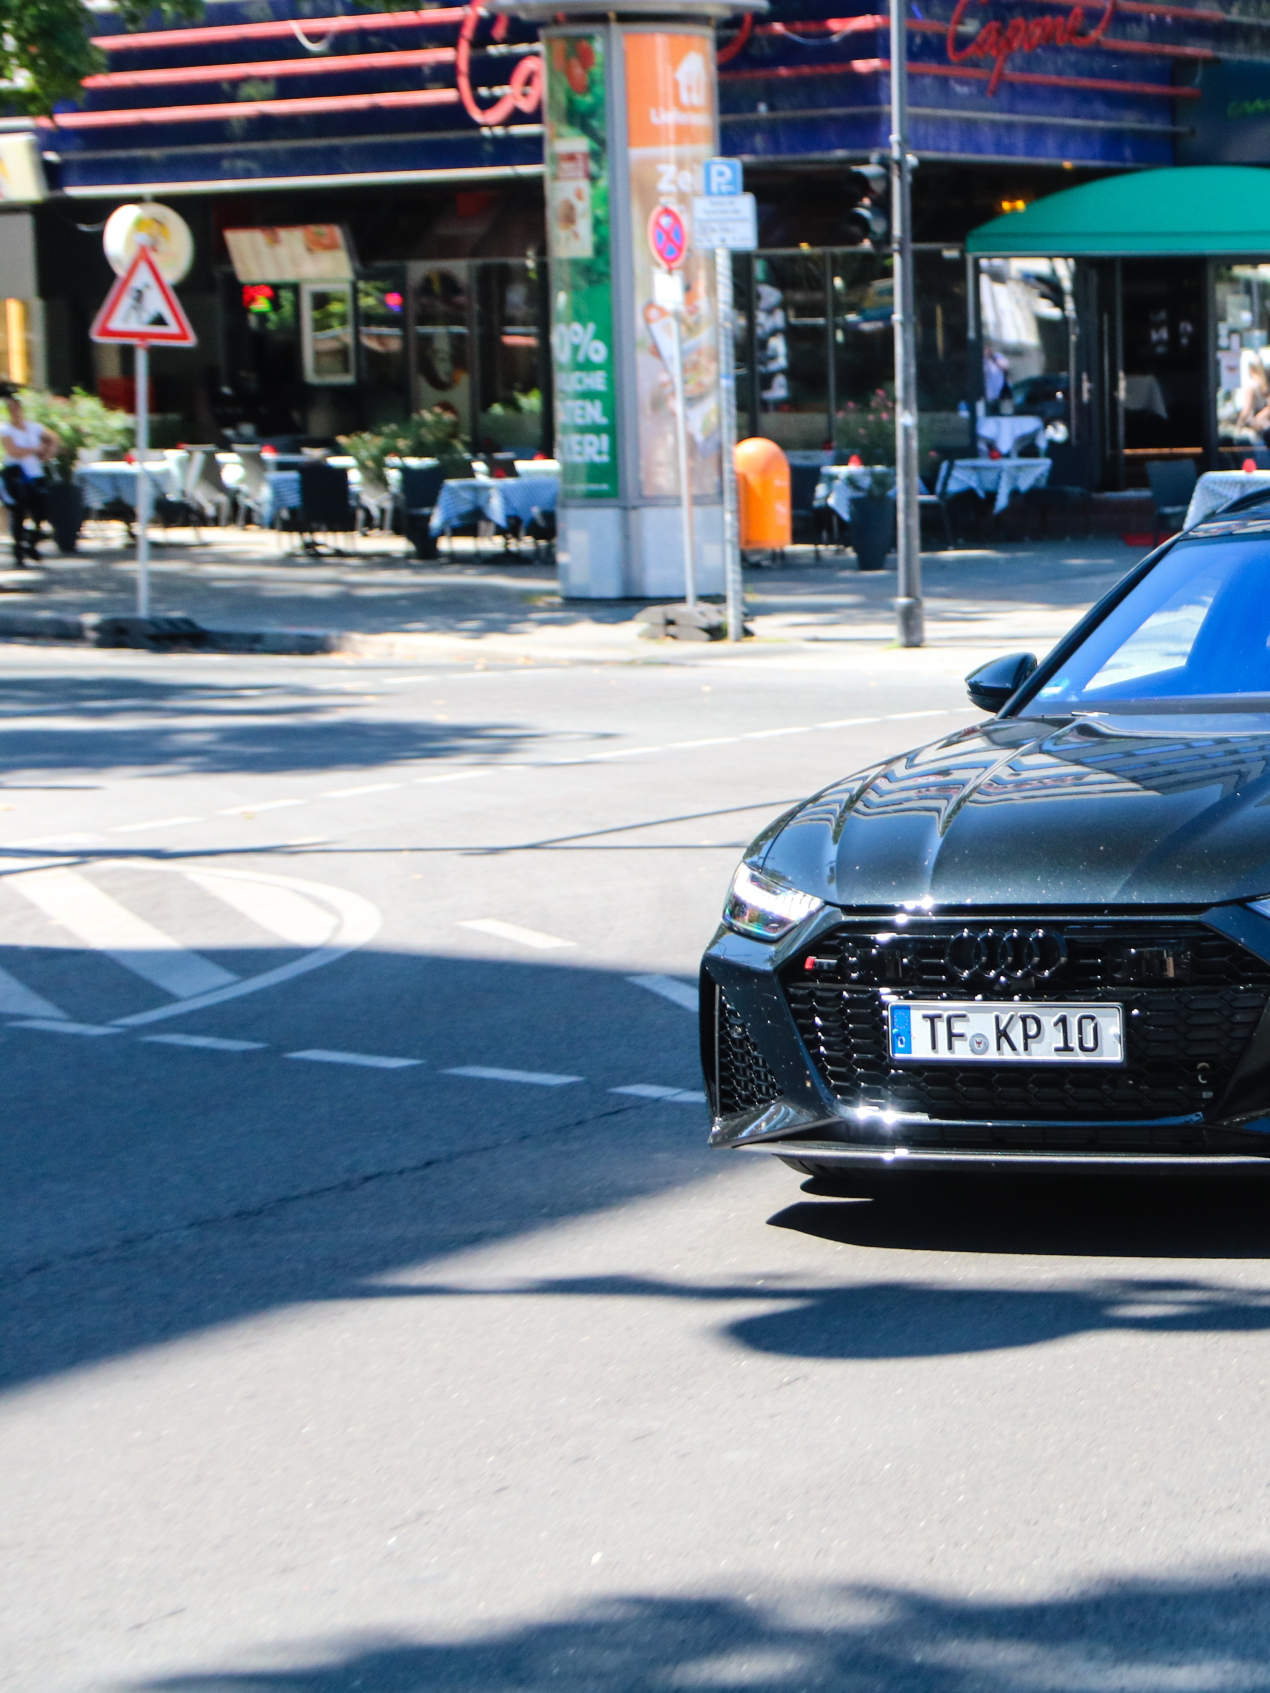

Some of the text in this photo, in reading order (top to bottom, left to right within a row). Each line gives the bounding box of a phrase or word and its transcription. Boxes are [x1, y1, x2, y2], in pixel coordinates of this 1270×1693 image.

[947, 0, 1115, 97] Capone
[922, 1012, 1099, 1053] TF KP 10
